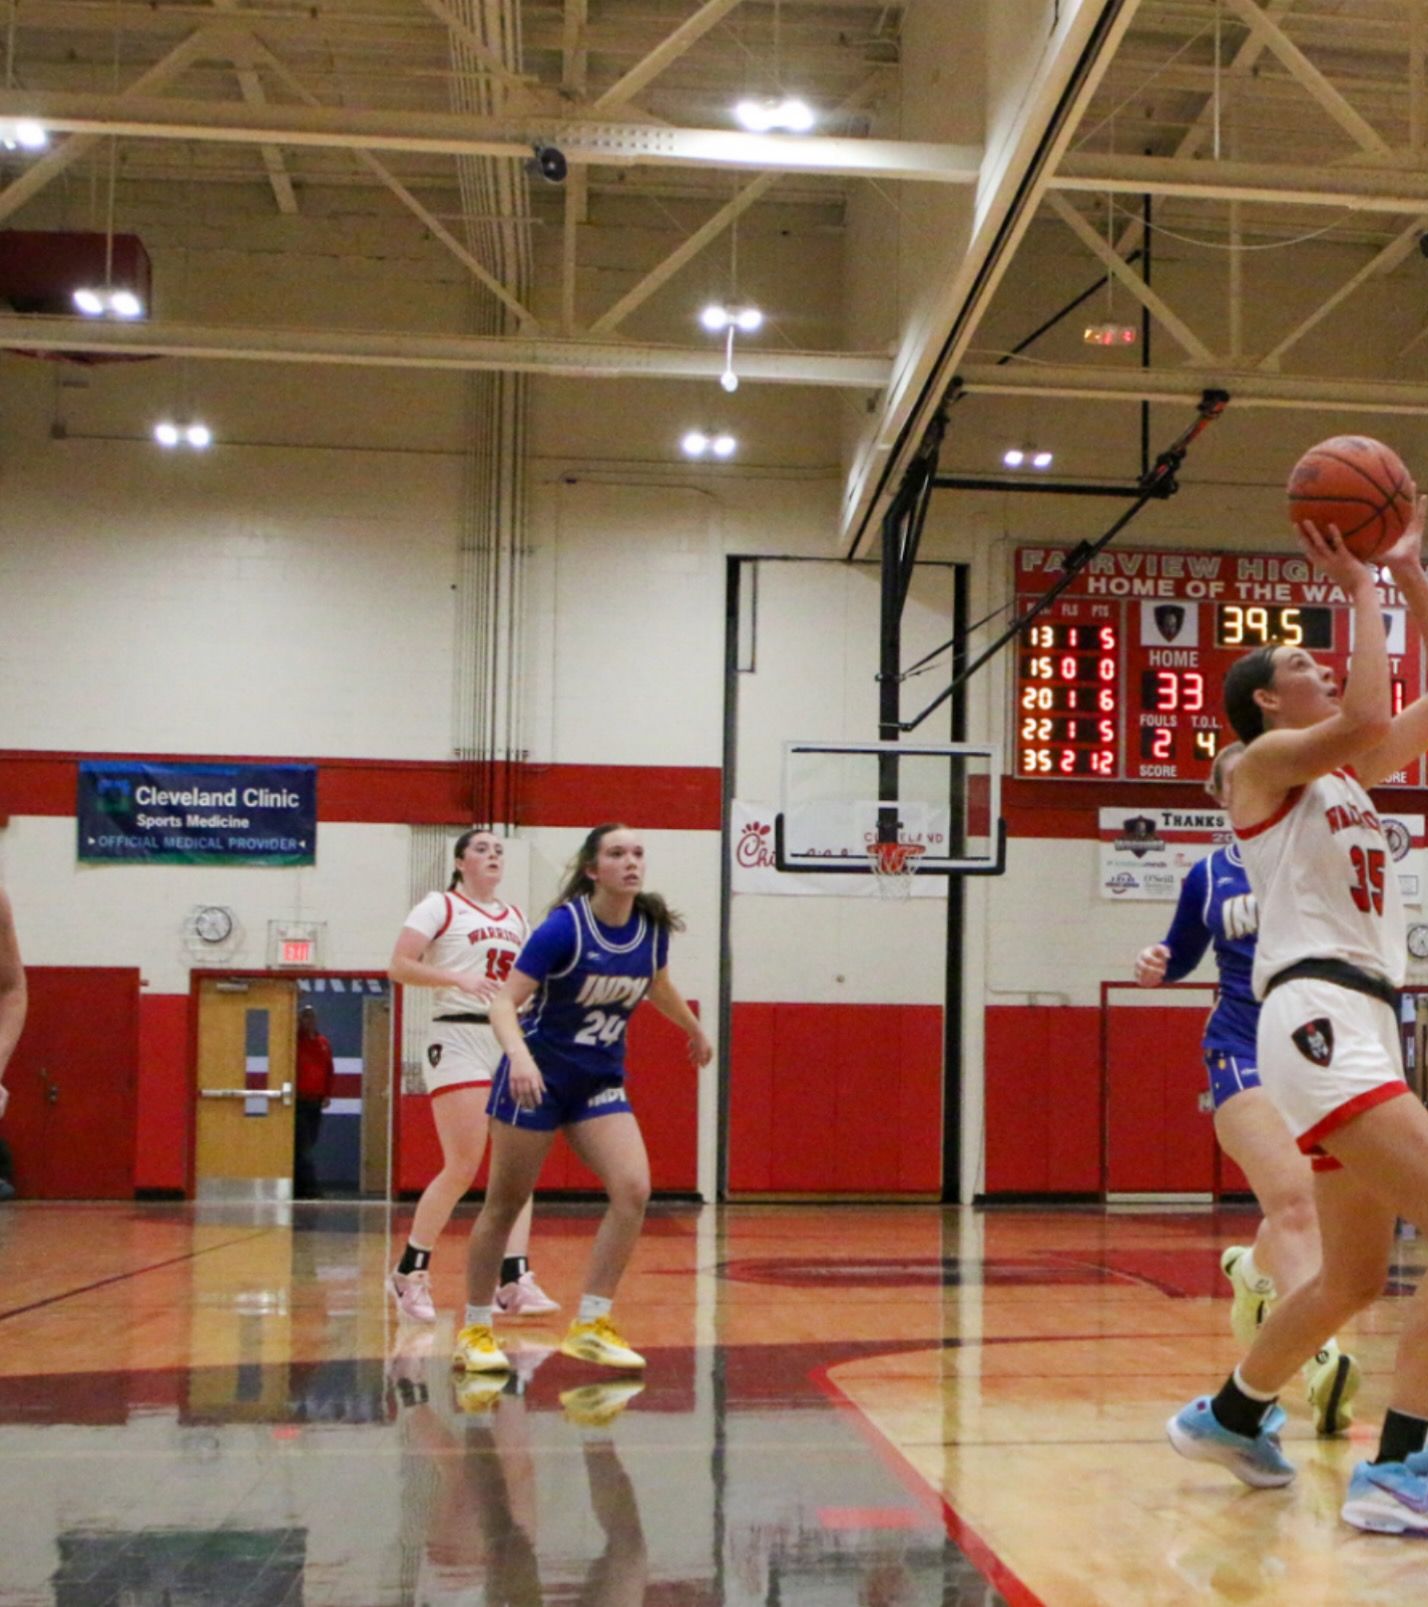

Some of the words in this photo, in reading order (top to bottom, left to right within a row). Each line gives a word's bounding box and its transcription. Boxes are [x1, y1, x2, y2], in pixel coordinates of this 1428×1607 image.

[1022, 549, 1222, 579] FARVIEW
[1088, 576, 1176, 597] HOME
[1185, 581, 1225, 598] OF
[1235, 582, 1292, 601] THE
[1031, 625, 1054, 648] 13
[1068, 628, 1078, 647] 1
[1223, 606, 1304, 646] 39.5
[1100, 627, 1116, 650] 5
[1030, 657, 1054, 680] 15
[1061, 657, 1077, 680] 0
[1099, 658, 1115, 681] 0
[1150, 651, 1199, 668] HOME
[1022, 687, 1053, 710] 20
[1068, 690, 1077, 709] 1
[1099, 689, 1115, 711] 6
[1157, 672, 1204, 710] 33
[1022, 718, 1053, 740] 22
[1068, 721, 1076, 739] 1
[1099, 720, 1114, 742] 5
[1140, 714, 1178, 728] FOULS
[1153, 729, 1172, 758] 2
[1196, 731, 1215, 758] 4
[1023, 749, 1053, 772] 35
[1060, 749, 1076, 773] 2
[1140, 764, 1178, 778] SCORE
[1380, 770, 1408, 784] ORE
[135, 785, 237, 808] Cleveland
[242, 788, 300, 808] Clinic
[136, 813, 183, 830] Sports
[186, 815, 250, 829] Medicine
[99, 835, 159, 849] OFFICIAL
[163, 836, 224, 850] MEDICAL
[228, 837, 298, 850] PROVIDER
[1349, 845, 1386, 917] 35
[485, 947, 517, 982] 15
[575, 974, 650, 1009] INDY
[574, 1009, 627, 1047] 24
